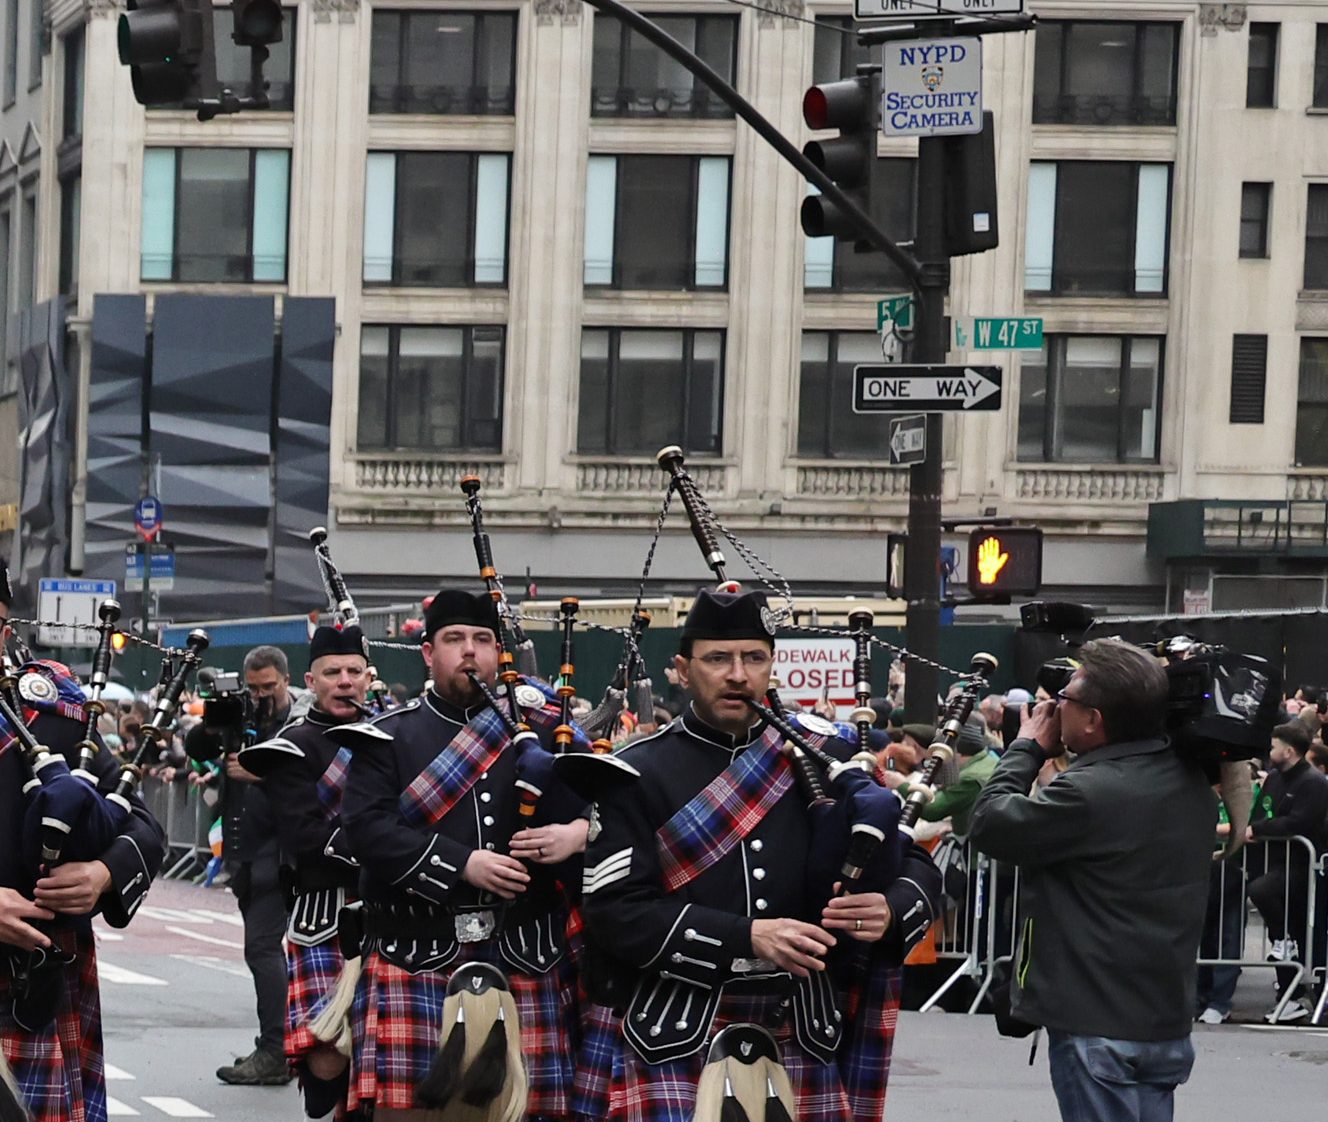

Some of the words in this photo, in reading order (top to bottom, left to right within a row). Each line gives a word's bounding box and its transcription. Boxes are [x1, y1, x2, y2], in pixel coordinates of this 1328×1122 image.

[899, 44, 966, 66] NYPD
[887, 91, 978, 110] SECURITY
[891, 111, 974, 130] CAMERA
[979, 321, 992, 346] W
[998, 320, 1019, 347] 47
[1022, 320, 1038, 335] ST
[868, 380, 911, 397] ONE
[937, 379, 982, 397] WAY
[773, 649, 850, 663] DEWALK
[773, 669, 855, 688] LOSED
